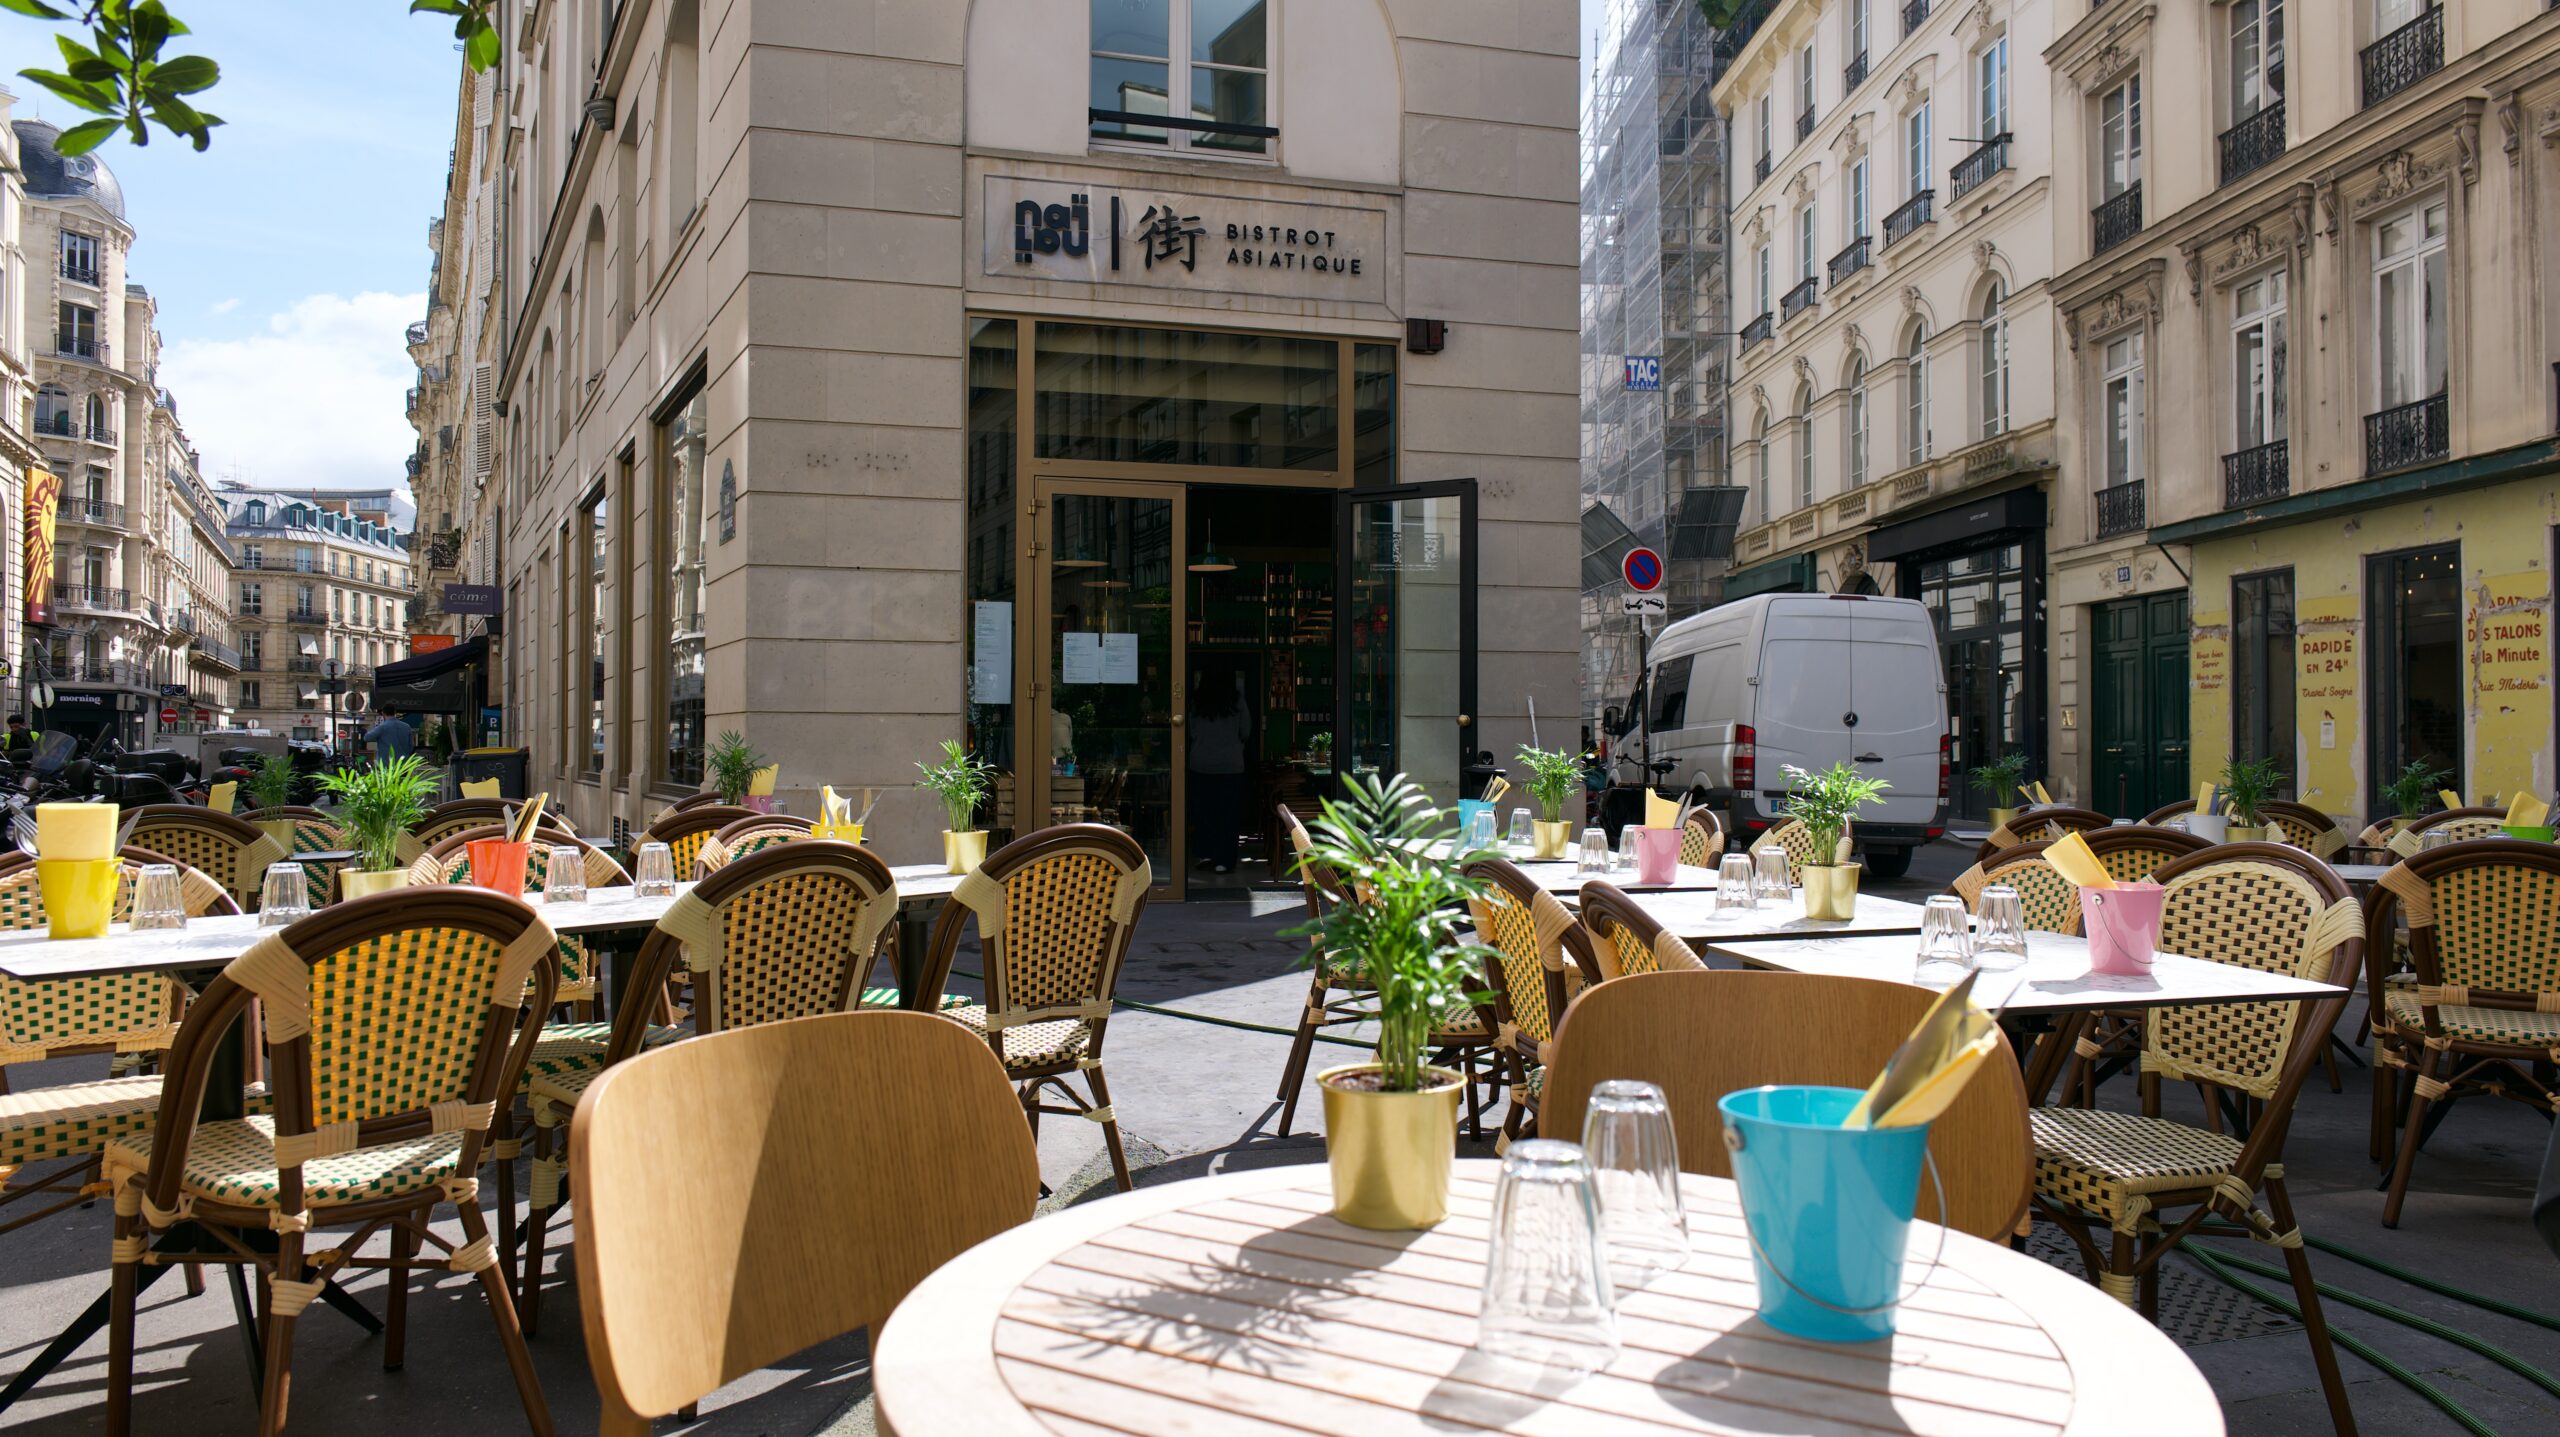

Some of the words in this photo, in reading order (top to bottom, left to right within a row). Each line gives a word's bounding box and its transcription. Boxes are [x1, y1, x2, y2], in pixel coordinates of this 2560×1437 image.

[1138, 205, 1207, 272] 街
[1226, 223, 1335, 248] BISTROT
[1227, 247, 1361, 275] ASIATIQUE
[1626, 359, 1658, 382] TAC
[2119, 567, 2129, 581] 23
[449, 590, 489, 602] côme
[2467, 628, 2491, 642] DS
[2494, 623, 2542, 641] TALONS
[2303, 639, 2352, 655] RAPIDE
[2482, 649, 2493, 664] la
[2497, 646, 2540, 663] Minute
[2306, 663, 2319, 674] EN
[59, 694, 102, 706] morning
[2302, 686, 2327, 698] Travail
